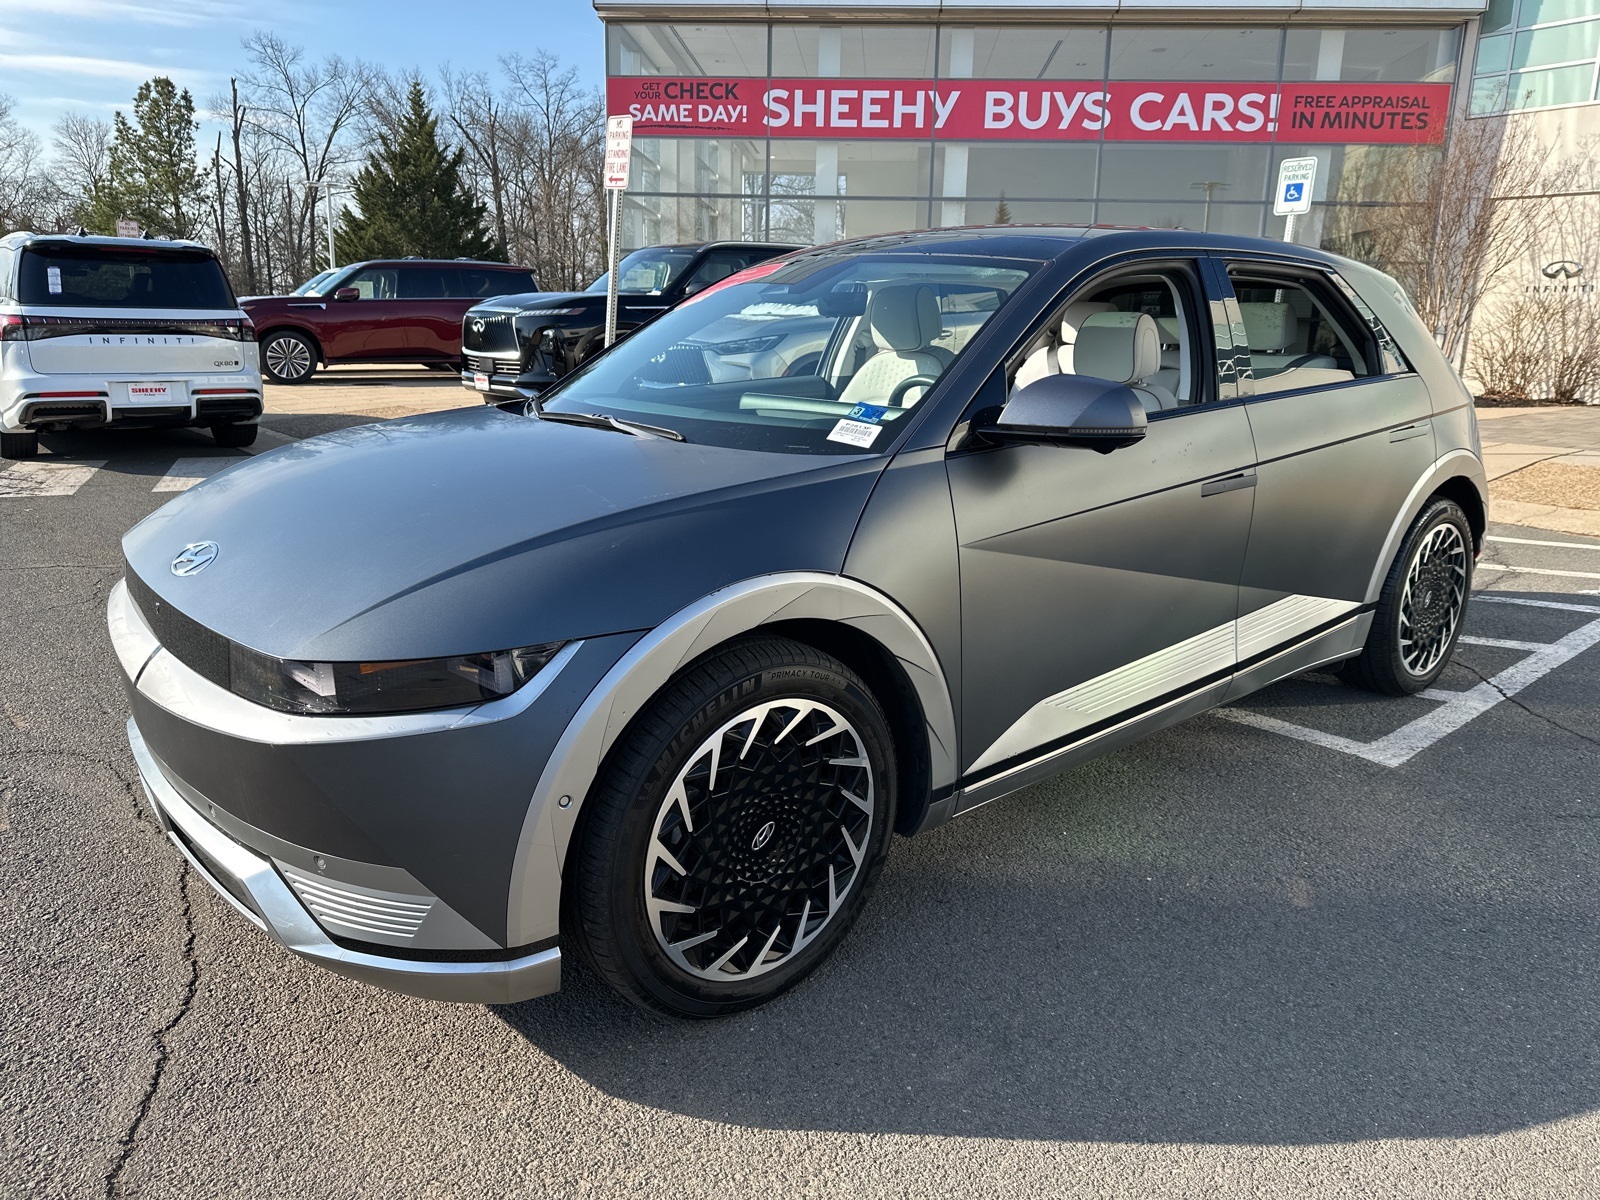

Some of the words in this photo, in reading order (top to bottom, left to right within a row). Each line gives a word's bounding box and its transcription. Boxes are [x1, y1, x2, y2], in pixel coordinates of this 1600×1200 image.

[641, 82, 661, 91] GET
[664, 82, 740, 100] CHECK
[634, 91, 661, 100] YOUR
[1293, 95, 1339, 108] FREE
[1340, 95, 1431, 110] APPRAISAL
[628, 103, 693, 123] SAME
[697, 104, 748, 123] DAY!
[762, 88, 962, 129] SHEEHY
[983, 90, 1112, 131] BUYS
[1129, 91, 1282, 133] CARS!
[1291, 111, 1316, 129] IN
[1319, 111, 1429, 131] MINUTES
[609, 130, 629, 140] PARKING
[607, 149, 629, 159] STANDING
[606, 161, 616, 173] FIRE
[616, 161, 628, 173] LANE
[1283, 163, 1314, 172] RESERVED
[1283, 172, 1310, 181] PARKING
[1525, 284, 1595, 293] INFINITI
[89, 336, 195, 344] INFINITI
[213, 360, 234, 368] QX80
[771, 669, 808, 681] PRIMACY
[810, 670, 830, 681] TOUR
[654, 677, 756, 775] MICHELIN
